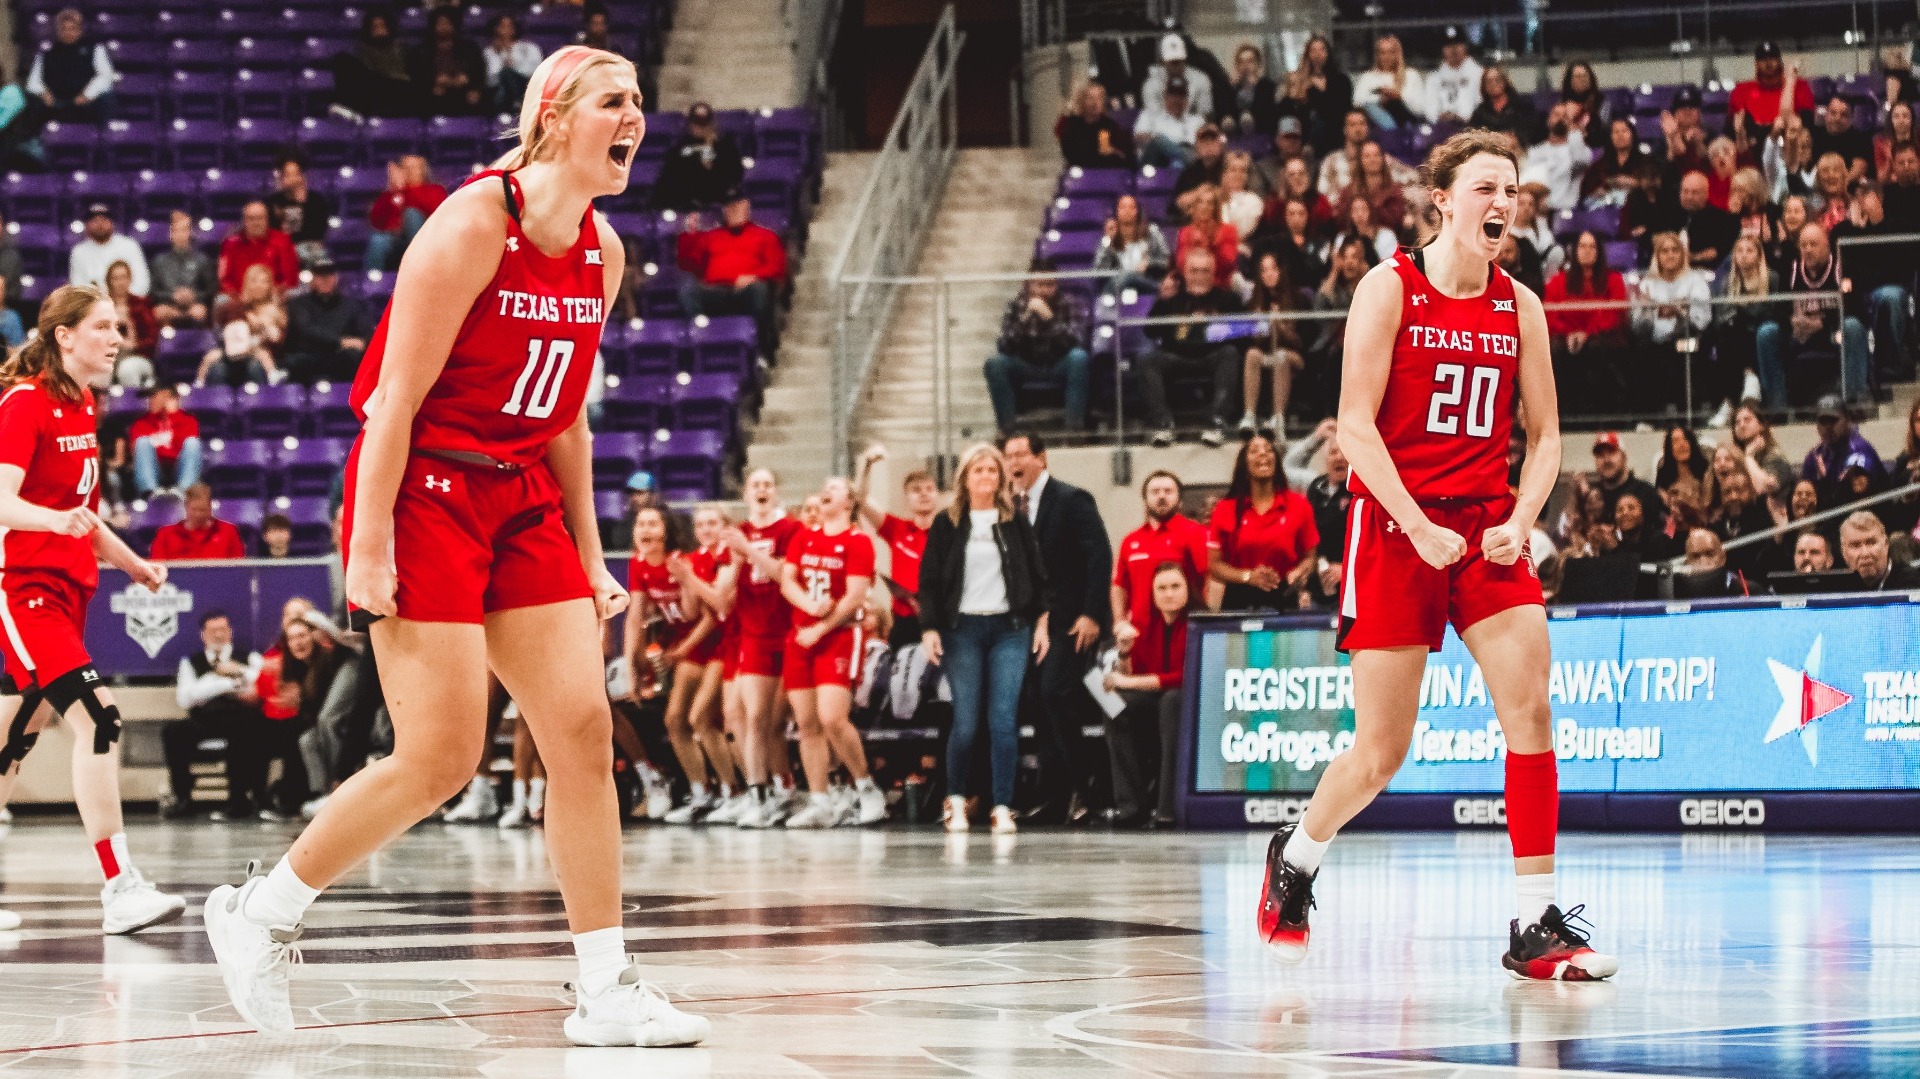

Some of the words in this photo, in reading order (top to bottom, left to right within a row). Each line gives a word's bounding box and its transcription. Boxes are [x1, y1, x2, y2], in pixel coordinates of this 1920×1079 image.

[499, 290, 559, 322] TEXAS
[563, 297, 602, 323] TECH
[1409, 326, 1473, 352] TEXAS
[1479, 333, 1518, 358] TECH
[501, 338, 575, 419] 10
[1427, 363, 1500, 438] 20
[56, 434, 88, 452] TEXAS
[1224, 666, 1355, 712] REGISTER
[1464, 663, 1487, 707] A
[1635, 656, 1716, 703] TRIP!
[1221, 721, 1356, 771] GoFrogs.c
[1454, 798, 1508, 824] GEIC
[1680, 798, 1766, 825] GEICO
